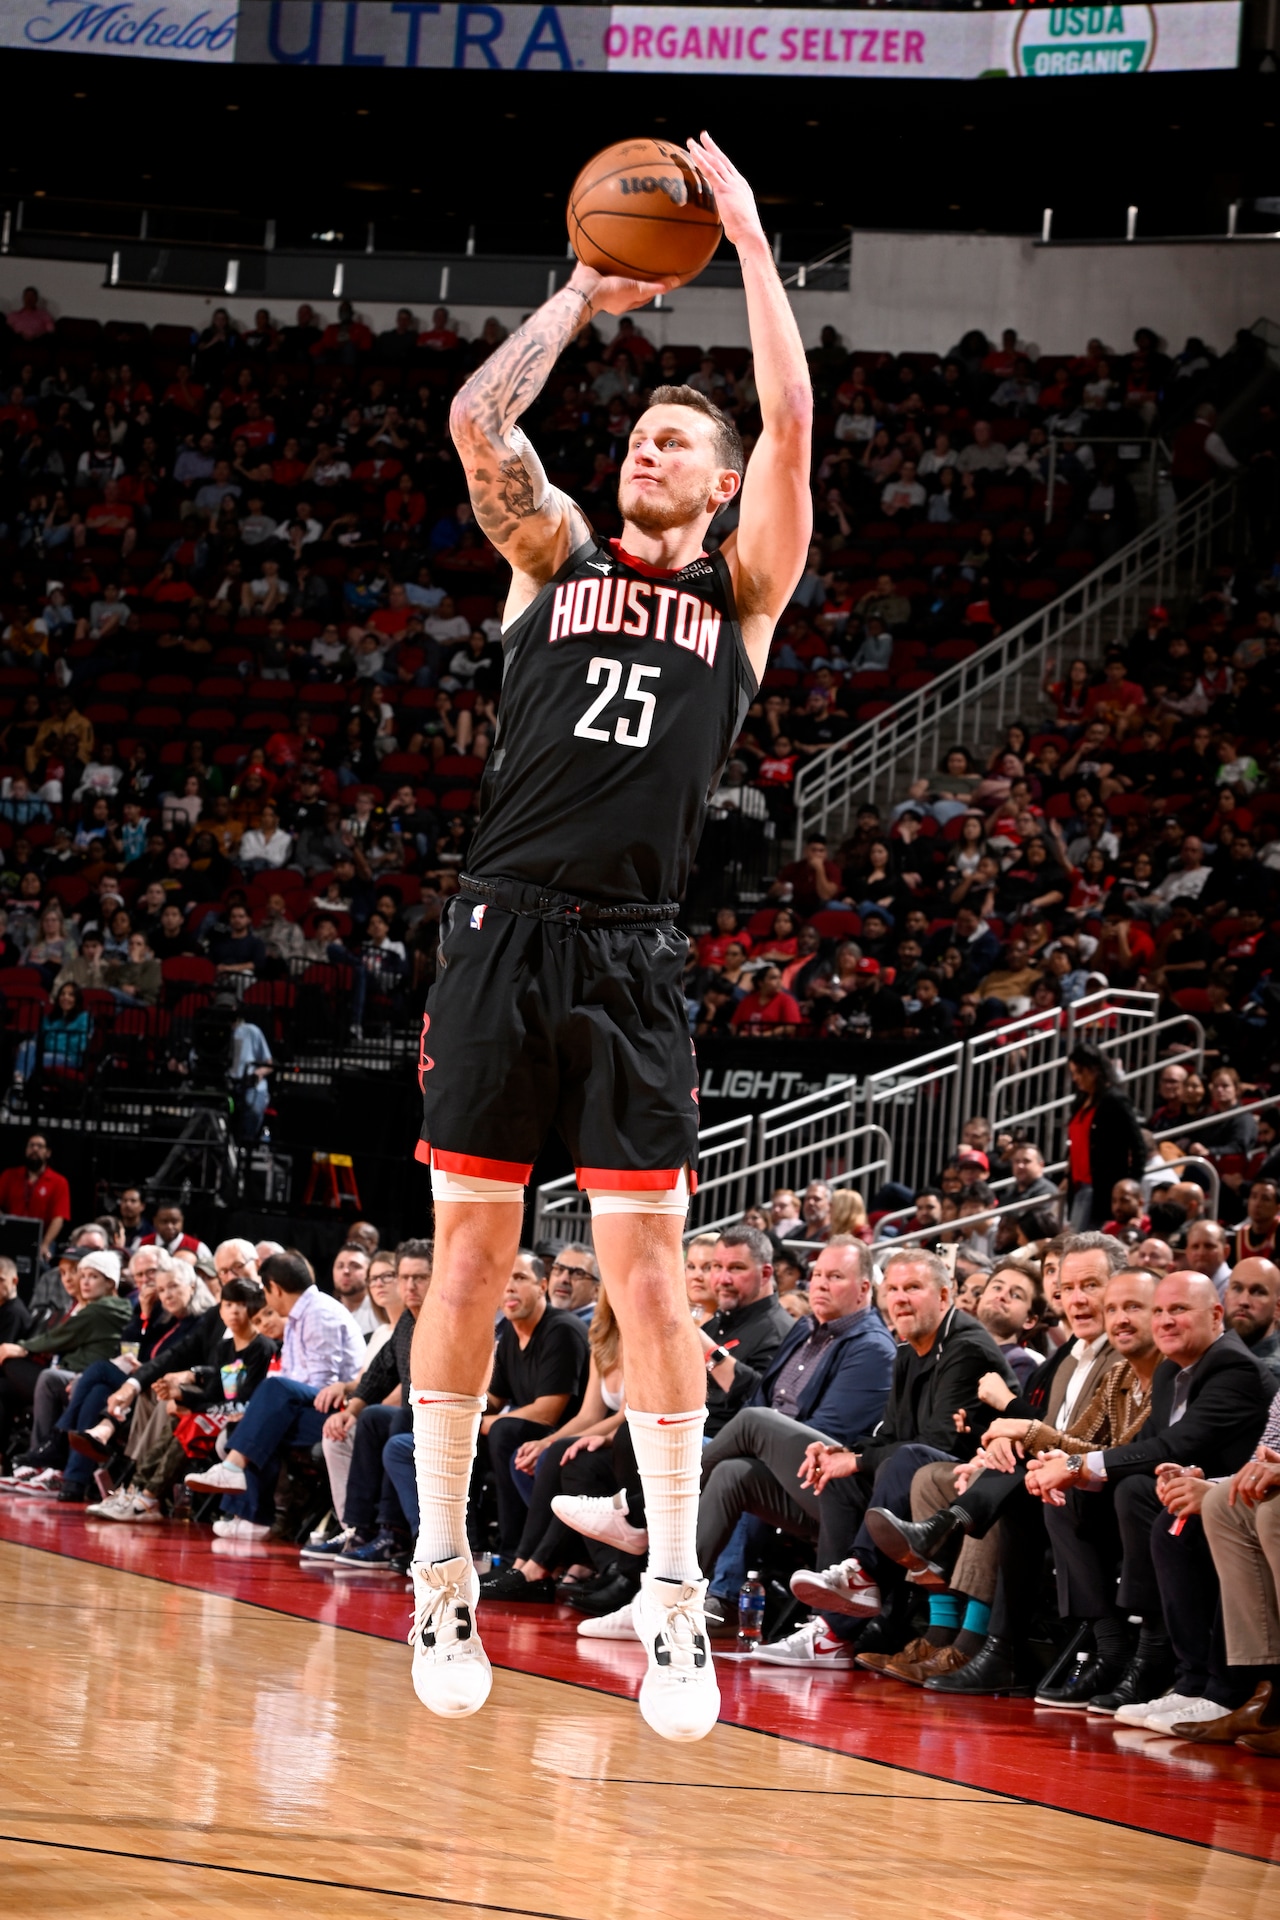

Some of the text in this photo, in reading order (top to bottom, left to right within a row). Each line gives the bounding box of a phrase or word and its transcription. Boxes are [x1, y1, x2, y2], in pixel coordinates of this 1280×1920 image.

[24, 0, 574, 71] Michelob ULTRA
[1049, 5, 1124, 37] USDA
[603, 24, 926, 64] ORGANIC SELTZER
[1034, 48, 1133, 77] ORGANIC
[548, 576, 723, 669] HOUSTON
[574, 656, 662, 748] 25
[701, 1069, 803, 1100] LIGHT
